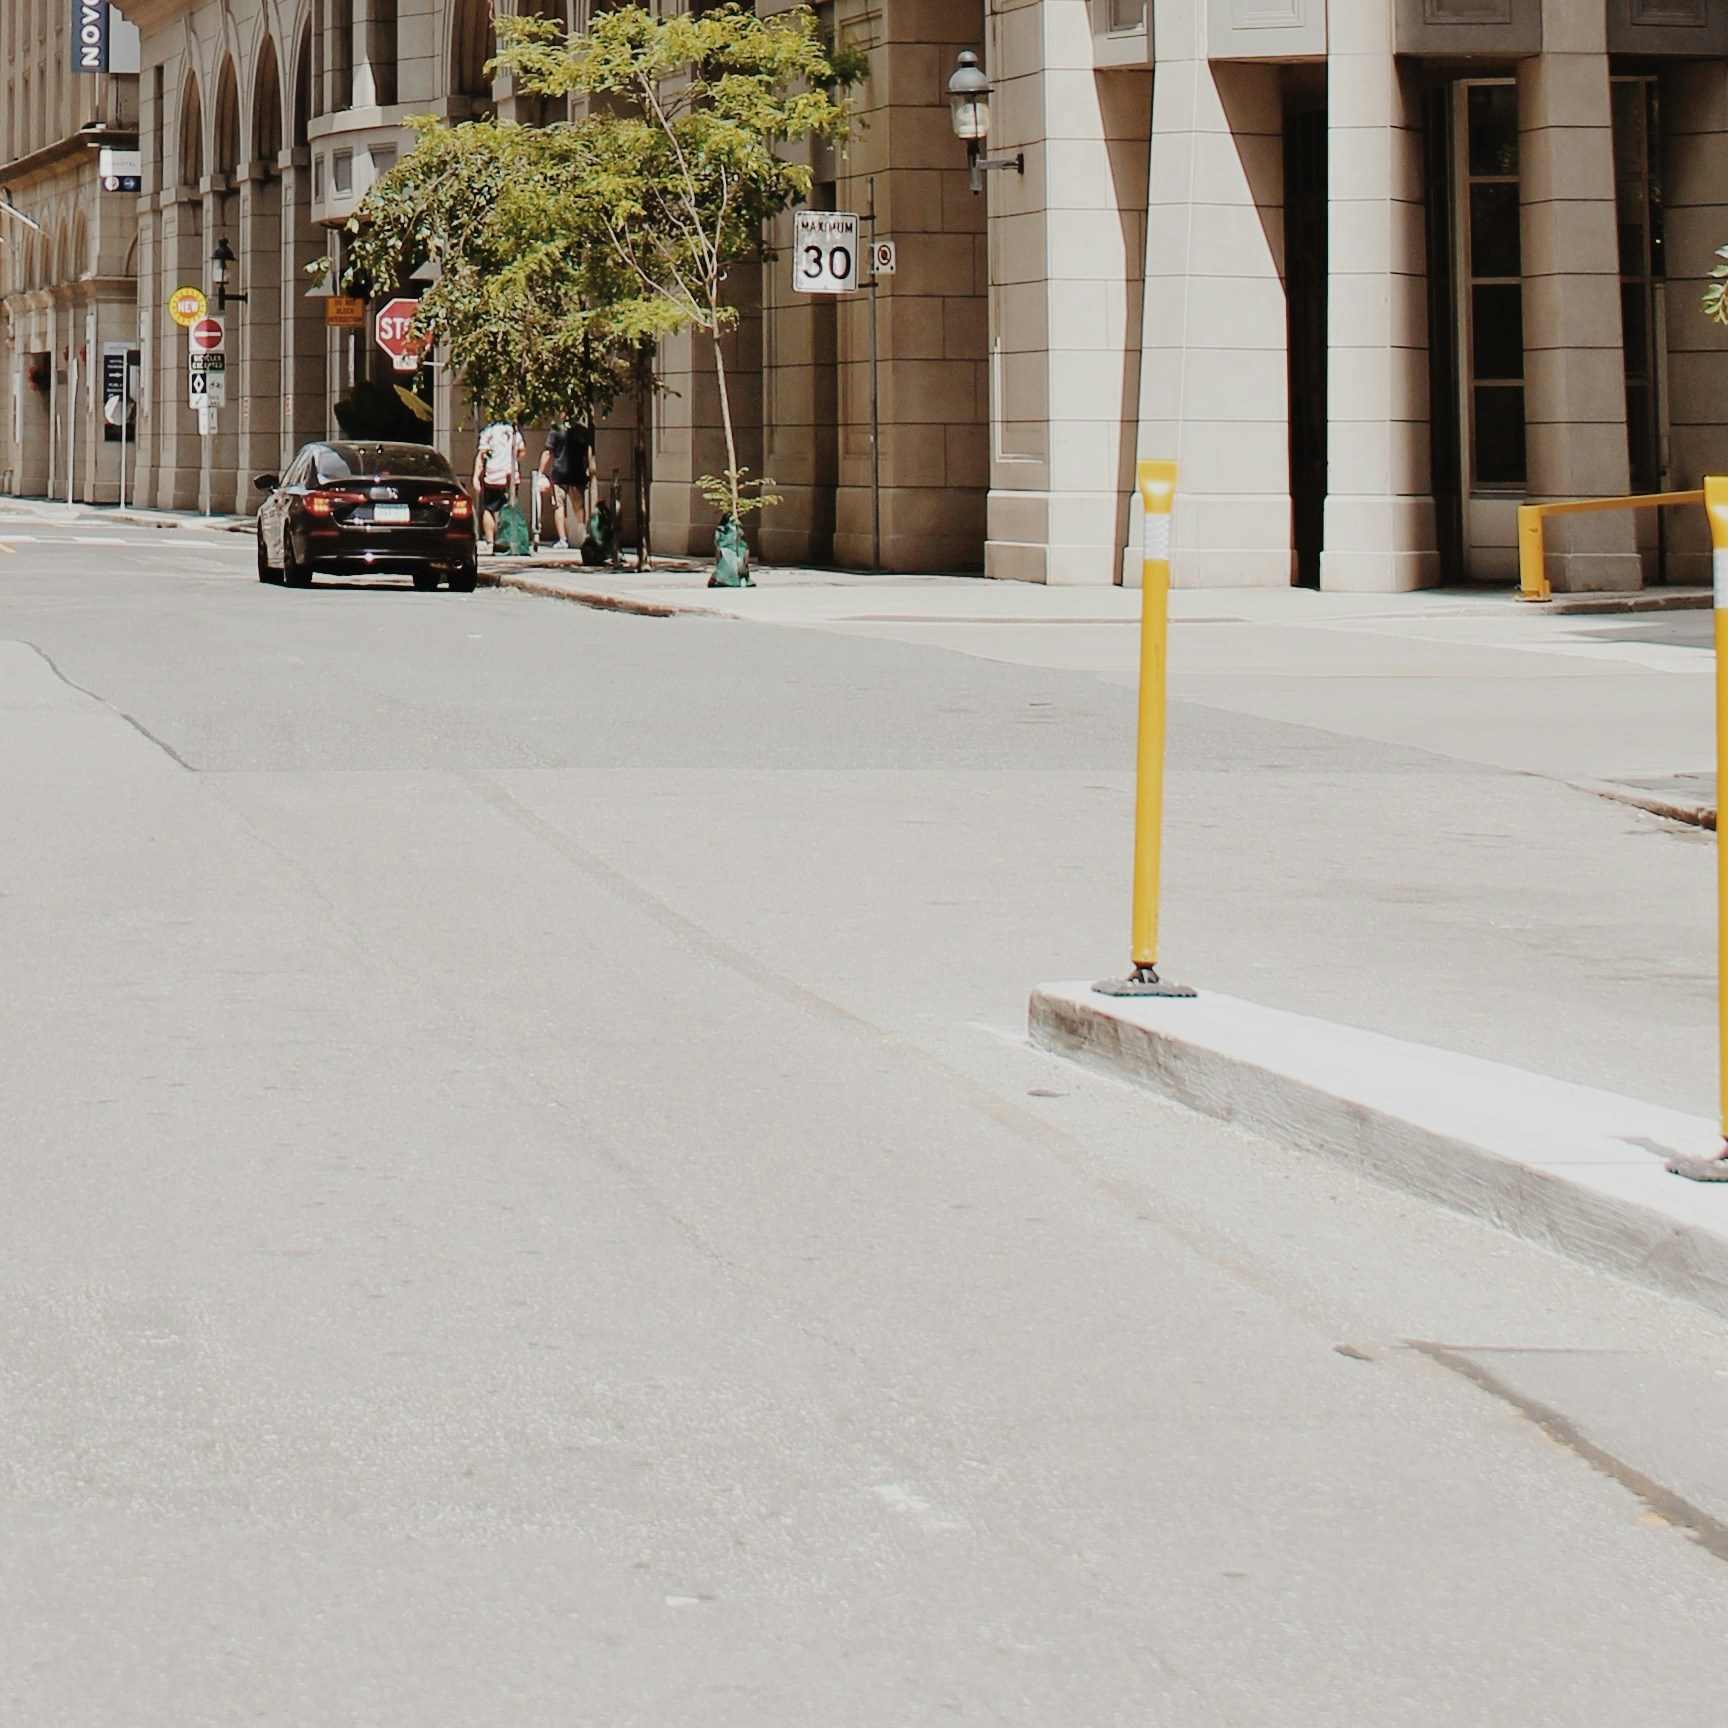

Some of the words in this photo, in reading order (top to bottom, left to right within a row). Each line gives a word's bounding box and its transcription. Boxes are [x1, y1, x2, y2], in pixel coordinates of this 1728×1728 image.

[803, 245, 851, 280] 30
[177, 300, 200, 313] NEW
[193, 354, 221, 362] BICYCLES
[192, 361, 222, 369] EXCEPTED
